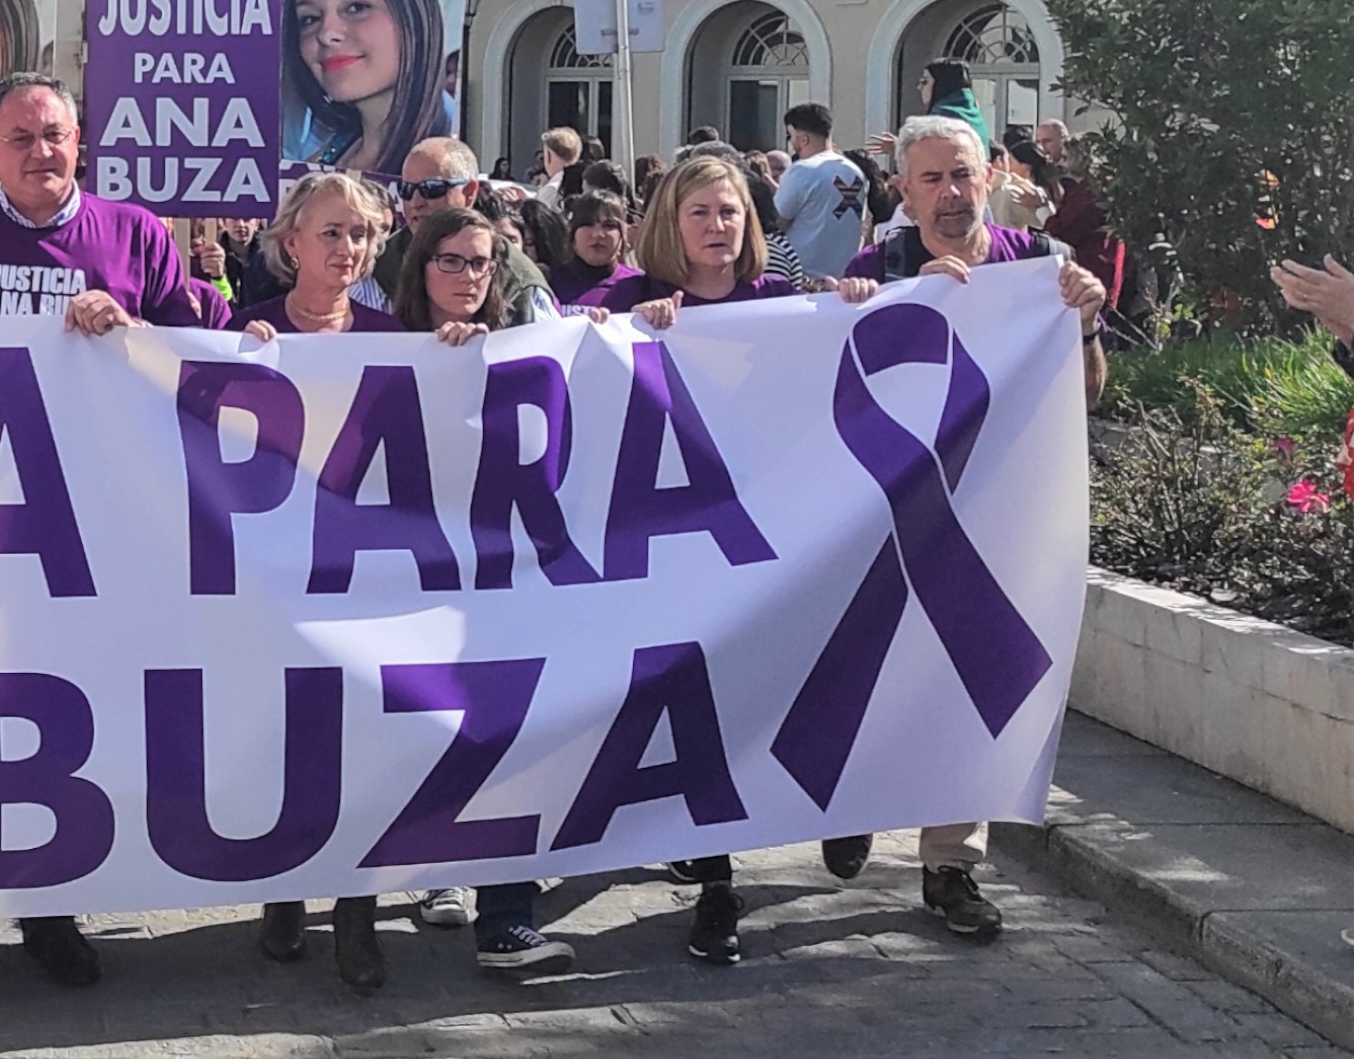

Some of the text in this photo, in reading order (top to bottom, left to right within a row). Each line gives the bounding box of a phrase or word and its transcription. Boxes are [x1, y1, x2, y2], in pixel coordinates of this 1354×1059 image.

[133, 52, 236, 84] PARA
[99, 97, 266, 148] ANA
[96, 156, 271, 203] BUZA
[176, 339, 779, 595] PARA
